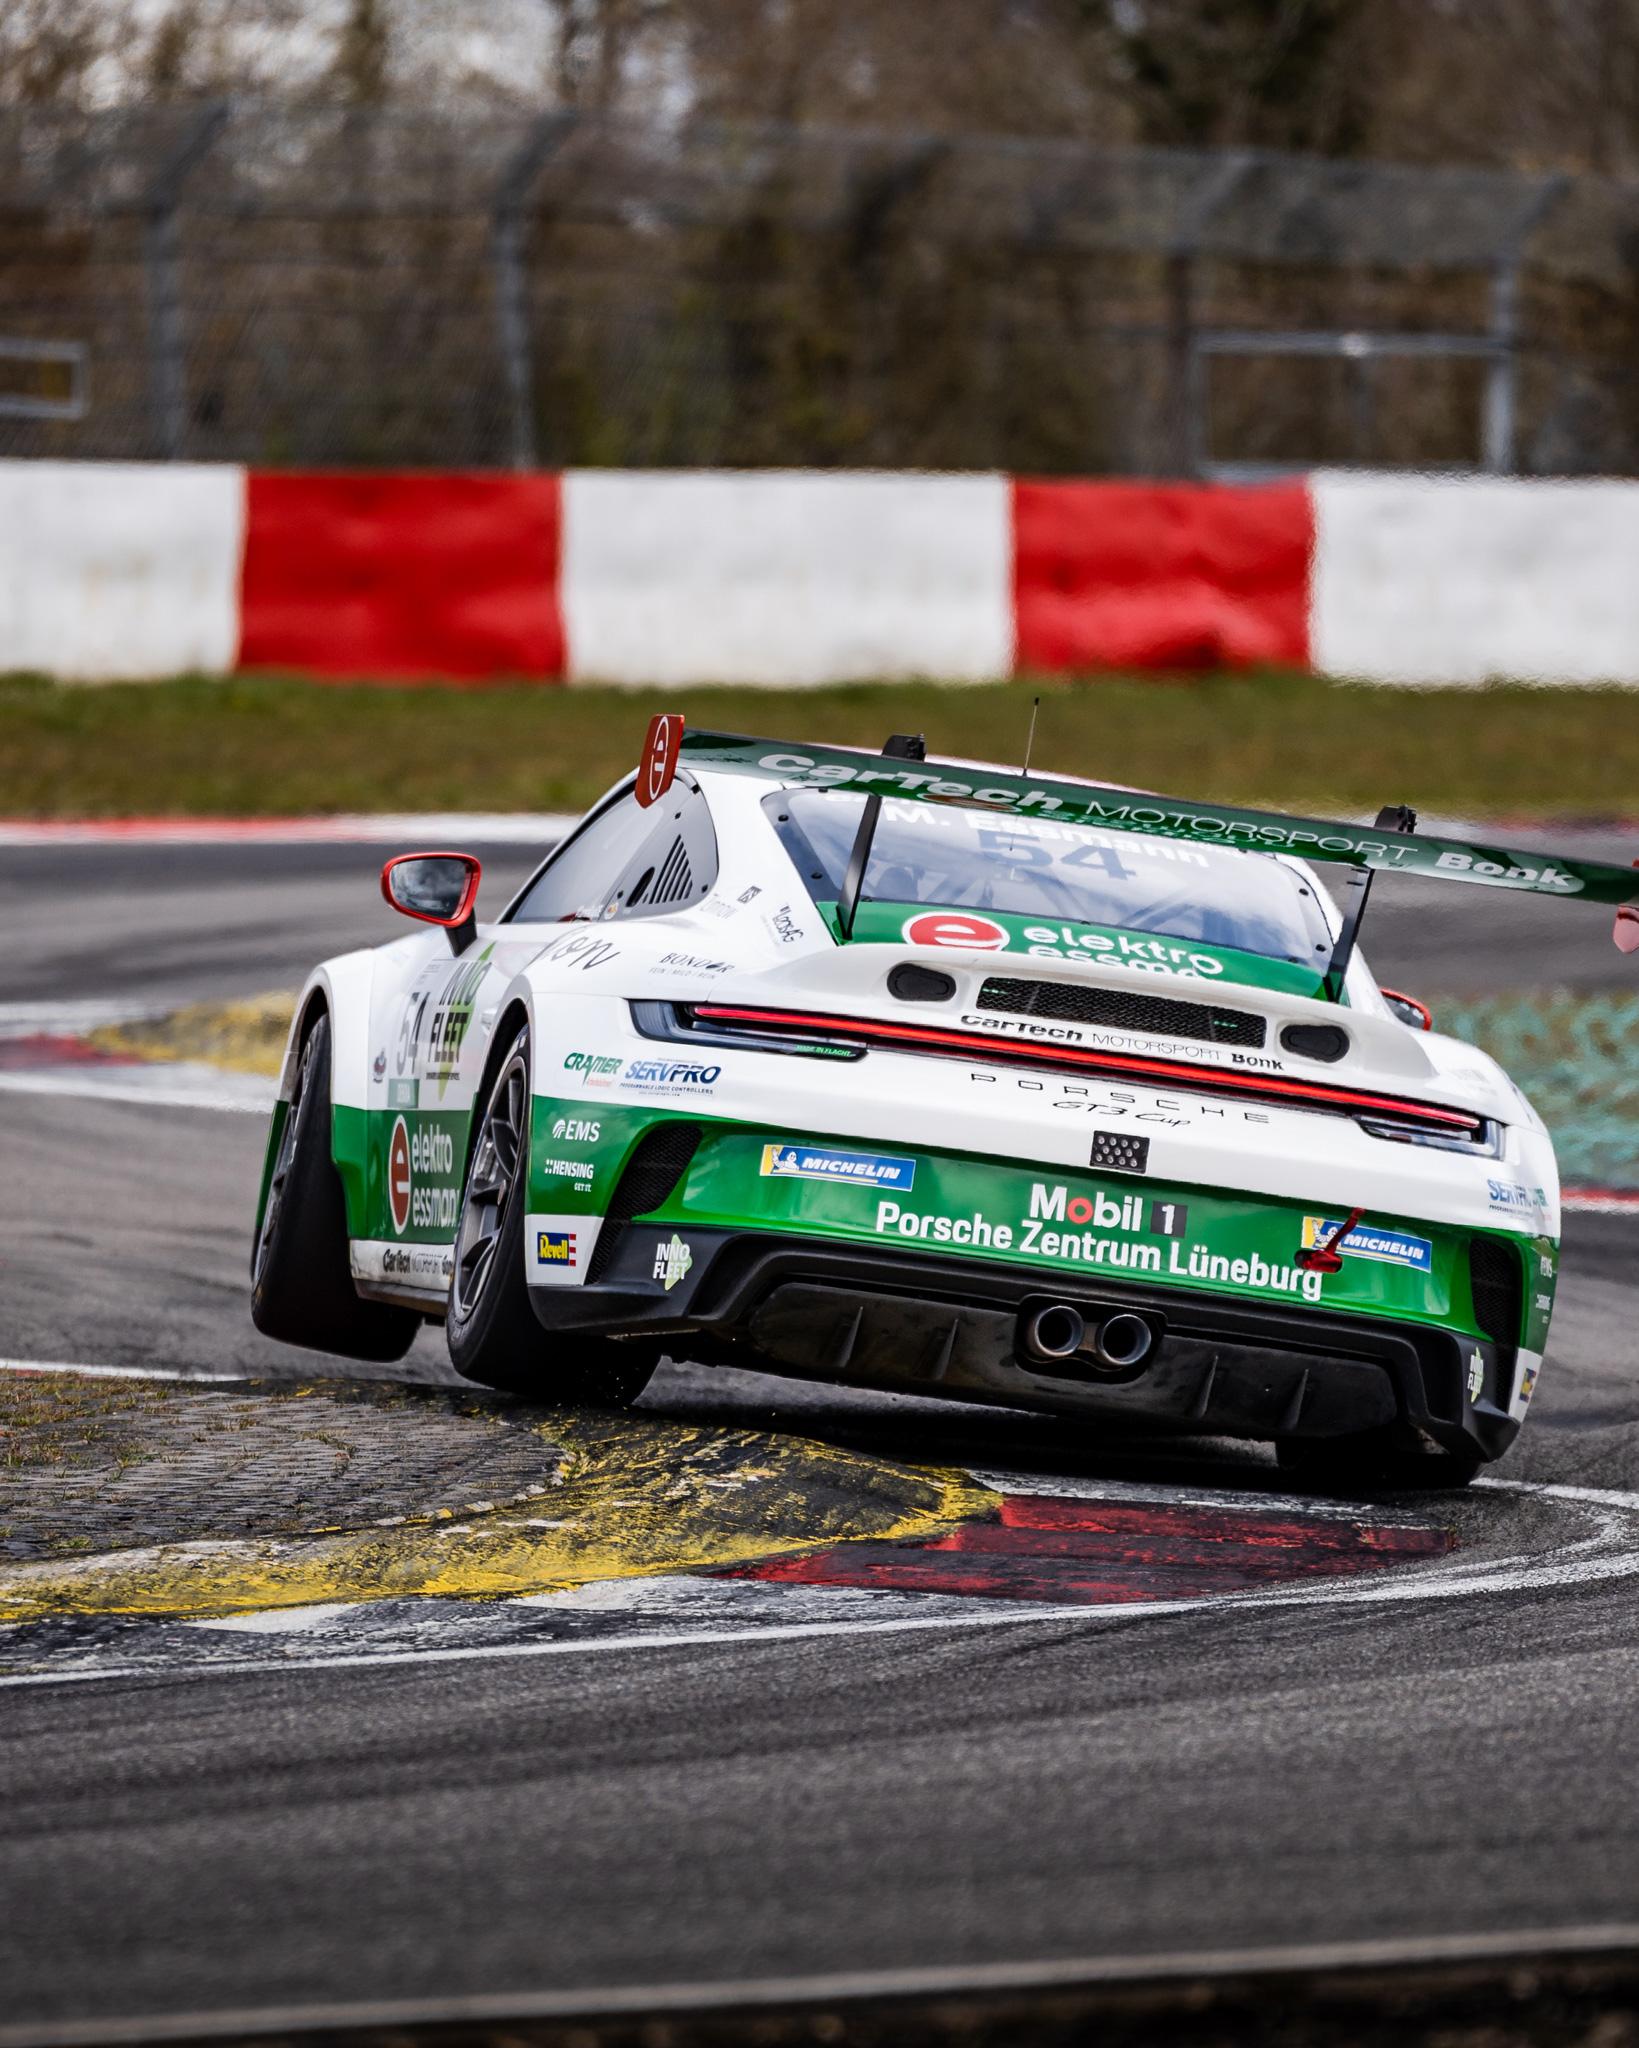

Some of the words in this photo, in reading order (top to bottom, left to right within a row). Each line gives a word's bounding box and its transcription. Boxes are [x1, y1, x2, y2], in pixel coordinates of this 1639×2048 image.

[758, 754, 1063, 809] CarTech
[1086, 801, 1418, 860] MOTORSPORT
[1435, 852, 1575, 887] Bonk
[884, 805, 950, 827] M.
[964, 811, 1210, 867] Essmann
[978, 829, 1137, 881] 54
[1023, 926, 1224, 975] elektro
[429, 1012, 470, 1063] FLEET
[961, 1014, 1083, 1043] CarTech
[1092, 1032, 1222, 1061] MOTORSPORT
[1231, 1053, 1285, 1071] Bonk
[625, 1059, 722, 1085] SERVPRO
[671, 1086, 714, 1096] CONTROLLERS
[970, 1073, 1270, 1124] PORSCHE
[1052, 1101, 1128, 1116] GT3
[1135, 1113, 1191, 1127] Cup
[412, 1123, 454, 1175] elektro
[564, 1119, 601, 1143] EMS
[552, 1160, 595, 1180] HENSING
[801, 1157, 902, 1180] MICHELIN
[1029, 1183, 1144, 1232] Mobil
[1161, 1204, 1177, 1235] 1
[539, 1234, 569, 1261] Revell
[655, 1243, 691, 1262] INNO
[875, 1200, 1013, 1250] Porsche
[1019, 1220, 1161, 1271] Zentrum
[1169, 1241, 1324, 1302] Lüneburg
[1343, 1233, 1424, 1260] MICHELIN
[652, 1261, 688, 1280] FLEET
